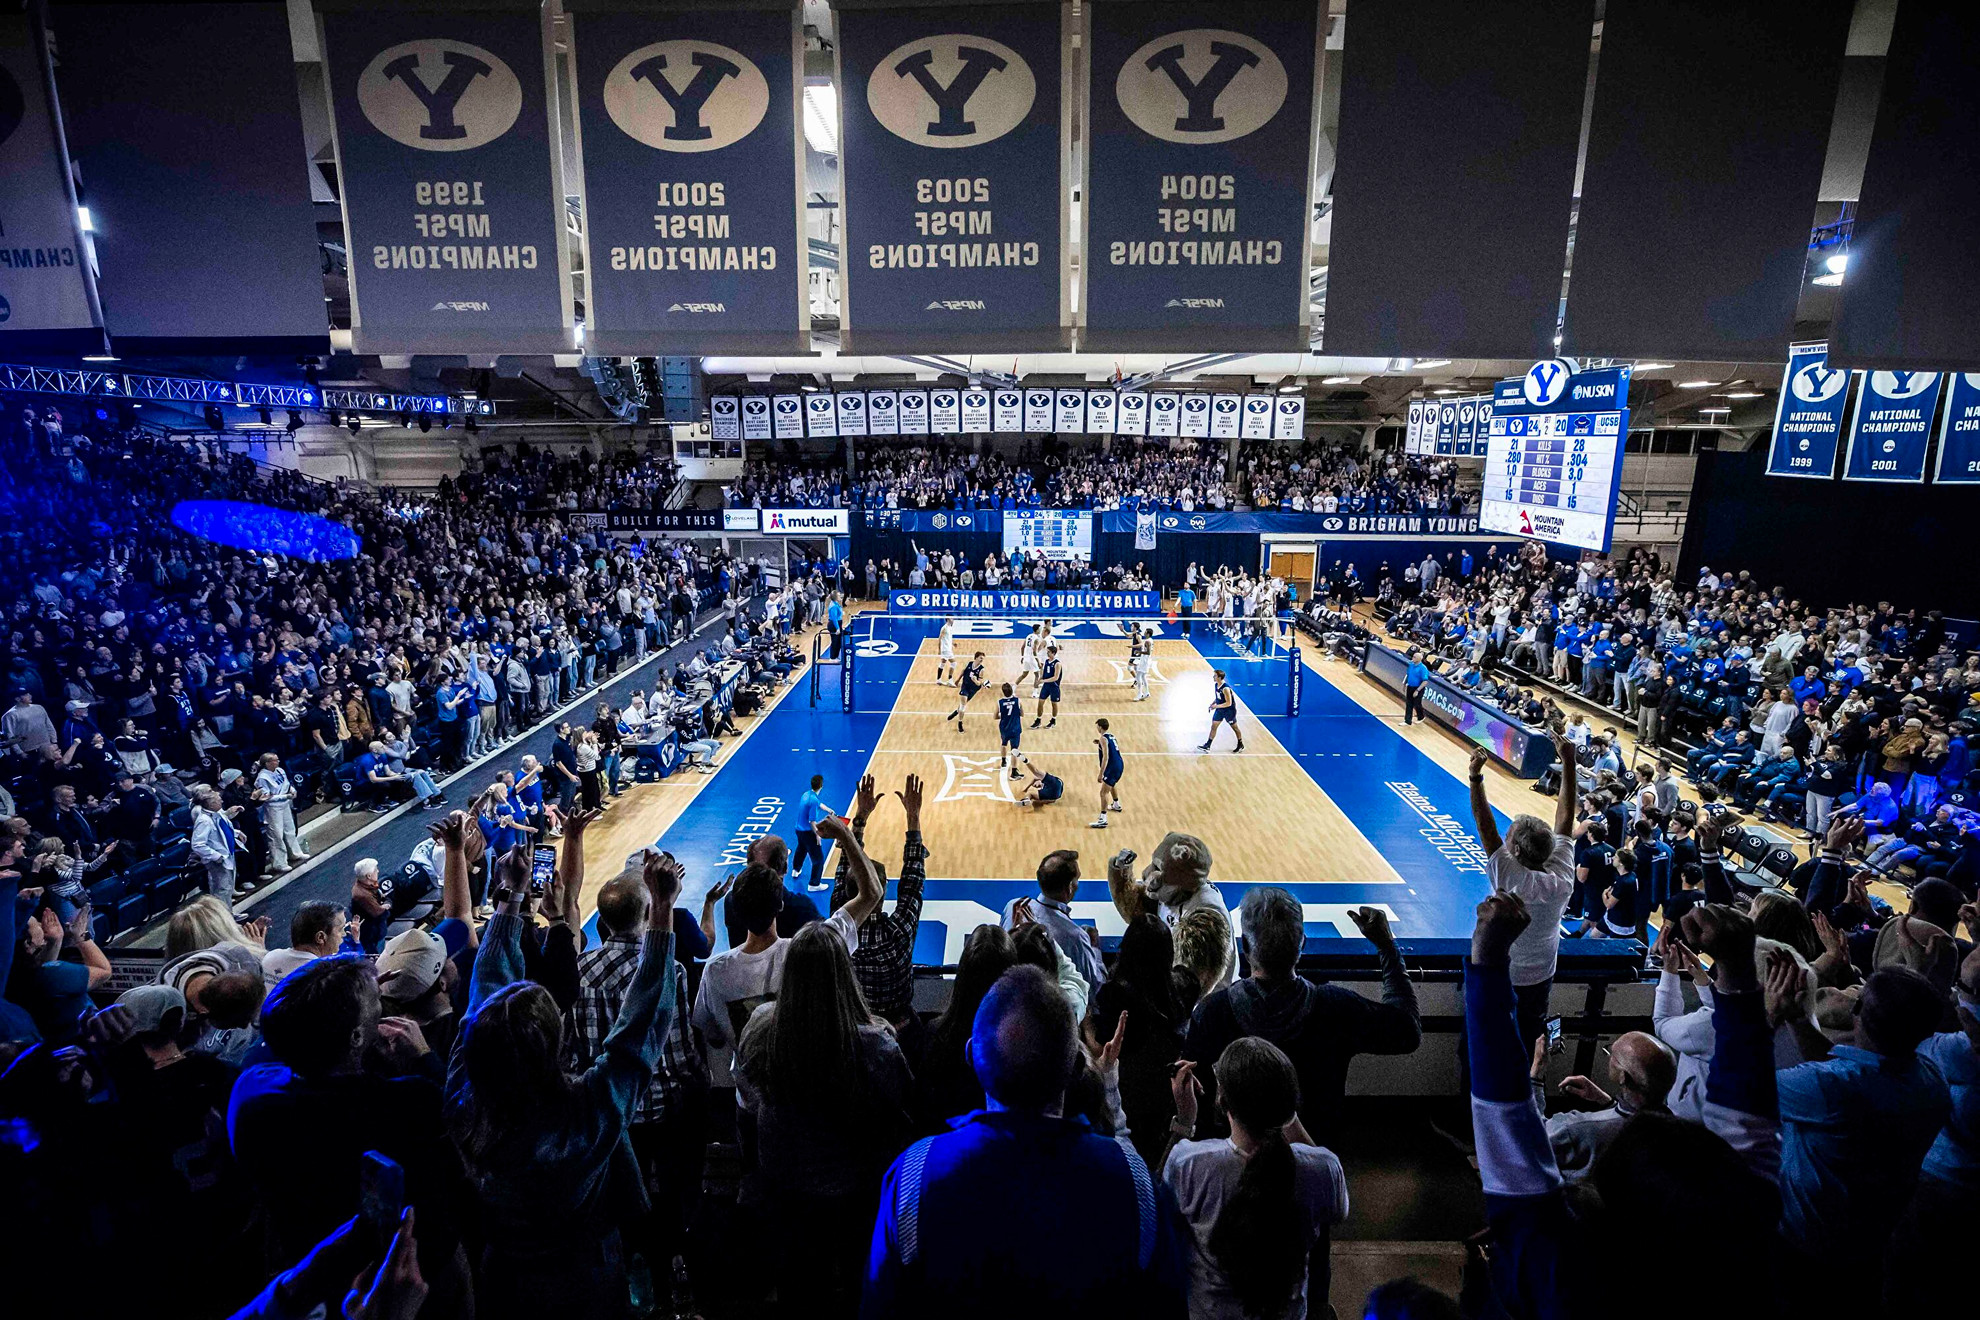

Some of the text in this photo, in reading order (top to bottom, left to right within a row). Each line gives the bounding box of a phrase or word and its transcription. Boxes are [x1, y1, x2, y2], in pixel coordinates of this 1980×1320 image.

[894, 47, 1005, 136] Y
[1145, 42, 1260, 132] Y
[383, 51, 492, 139] Y
[630, 52, 741, 140] Y
[1531, 364, 1560, 402] Y
[1790, 412, 1832, 421] NATIONAL
[1870, 409, 1921, 420] NATIONAL
[1528, 420, 1538, 432] 24
[1556, 421, 1566, 431] 20
[1601, 417, 1619, 426] UCSB
[1862, 422, 1925, 433] CHAMPIONS
[1545, 426, 1548, 435] 2
[1783, 423, 1836, 433] CHAMPIONS
[1511, 439, 1585, 451] 21 KILLS 28
[1505, 452, 1521, 463] .280
[1567, 454, 1588, 466] .304
[1790, 457, 1812, 467] 1999
[1872, 461, 1897, 470] 2001
[1507, 465, 1582, 480] 1.0 BLOCKS 3.0
[1509, 477, 1576, 494] 1 ACES 1
[1505, 489, 1512, 500] 15
[1568, 496, 1576, 508] 15
[614, 516, 716, 526] BUILT FOR THIS
[788, 515, 837, 527] mutual
[1348, 517, 1421, 531] BRIGHAM
[1427, 518, 1478, 532] YOUNG
[1534, 515, 1565, 526] MOUNTAIN
[1535, 525, 1560, 535] AMERICA
[921, 593, 994, 608] BRIGHAM
[1000, 594, 1050, 608] YOUNG
[1057, 594, 1150, 608] VOLLEYBALL
[846, 655, 850, 668] GO
[1294, 659, 1299, 672] GO
[1007, 706, 1013, 716] 7
[1391, 782, 1438, 812] Elaine
[1419, 829, 1487, 875] COURT
